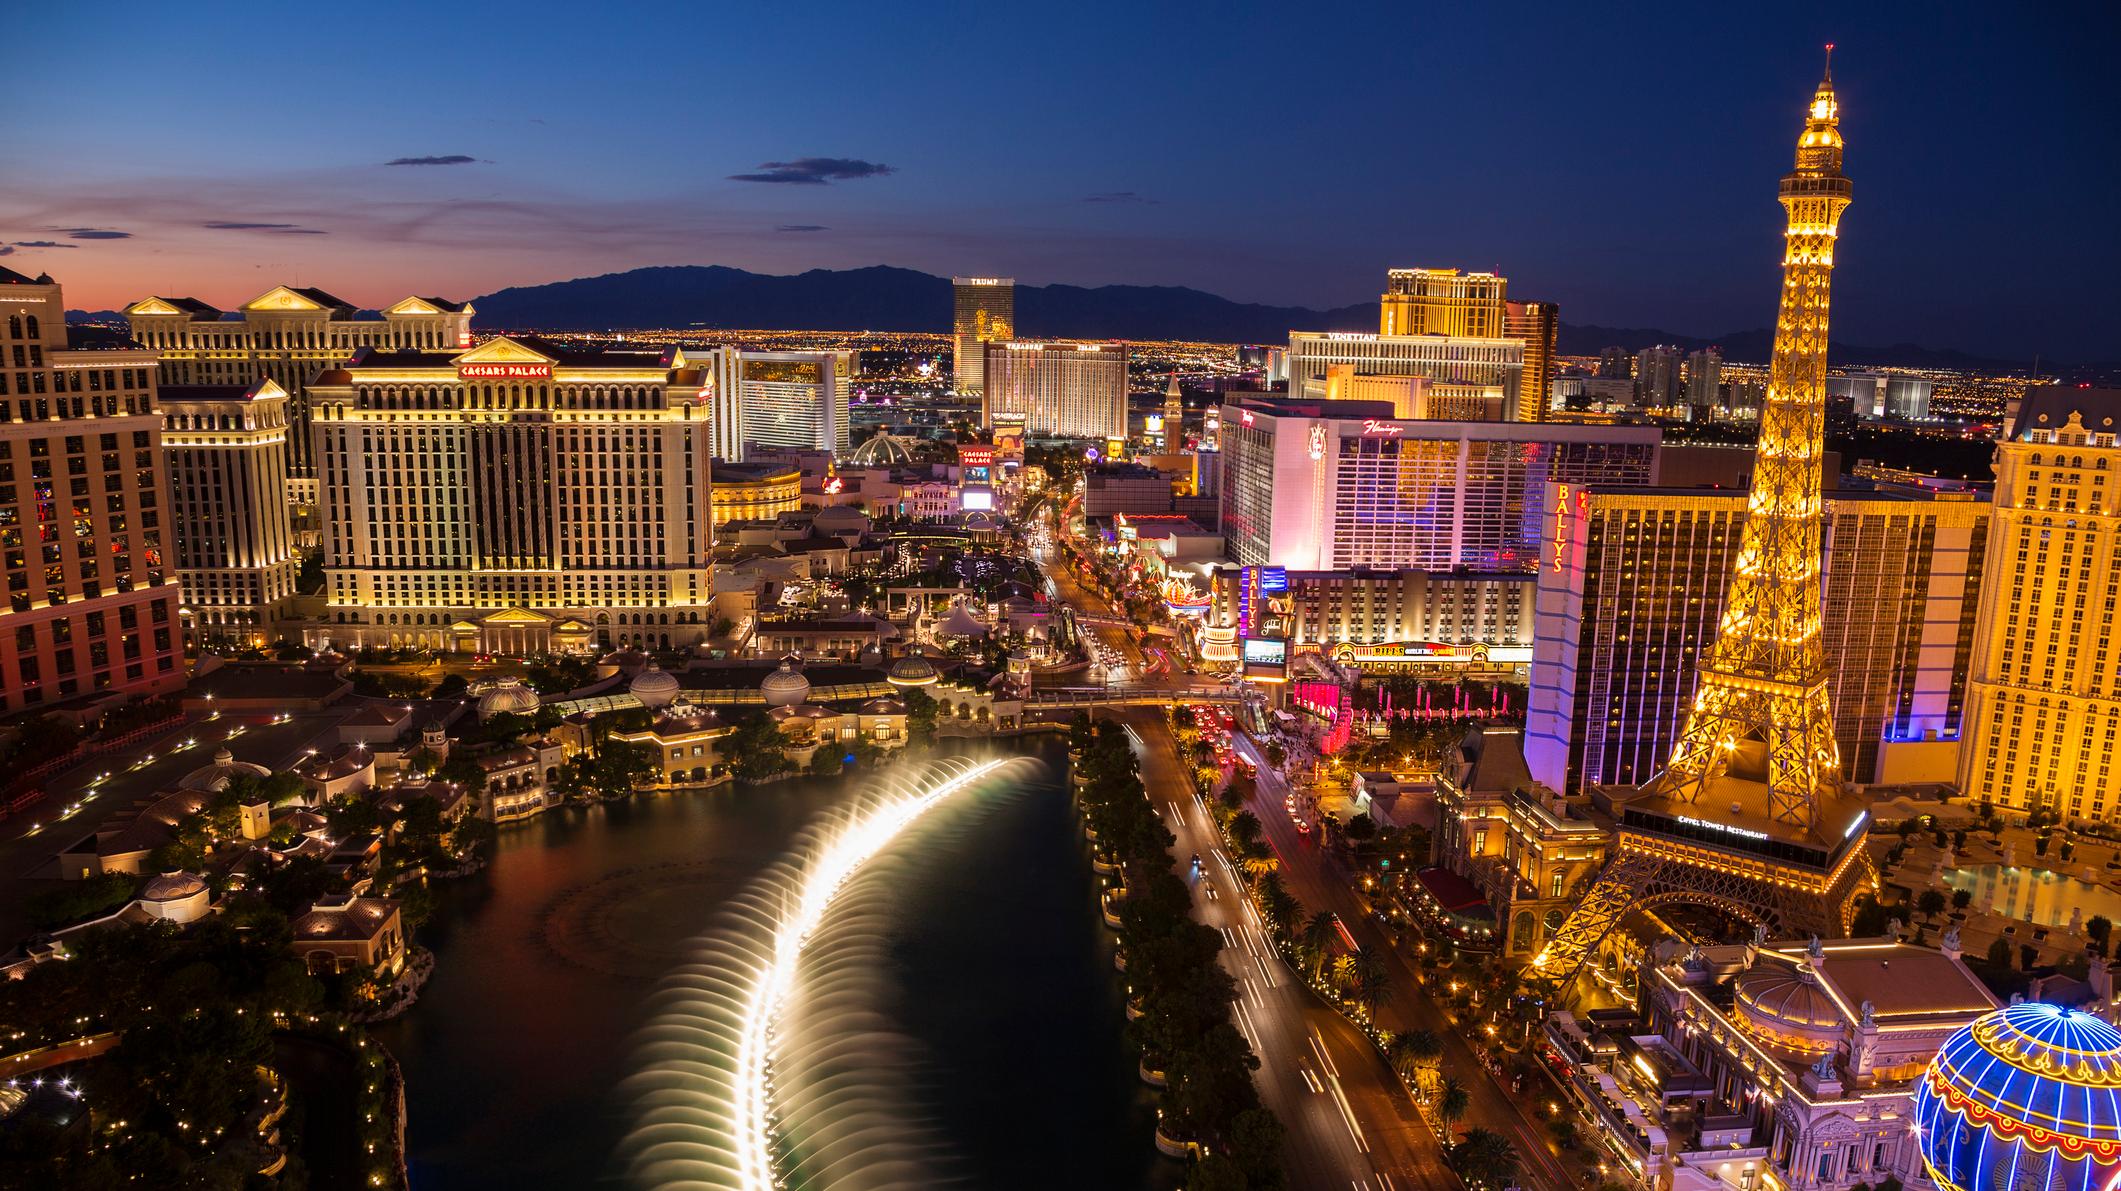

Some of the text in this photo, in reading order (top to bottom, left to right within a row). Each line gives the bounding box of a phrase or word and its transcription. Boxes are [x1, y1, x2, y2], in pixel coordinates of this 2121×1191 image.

[971, 278, 998, 286] TRUMP
[1328, 332, 1378, 341] VENETIAN
[461, 367, 548, 376] CAESARS PALACE
[1363, 420, 1403, 435] Flamingo
[1553, 484, 1569, 573] BALLYS
[1249, 569, 1258, 629] BALLYS
[1678, 815, 1768, 840] EIFFEL TOWER RESTAURANT
